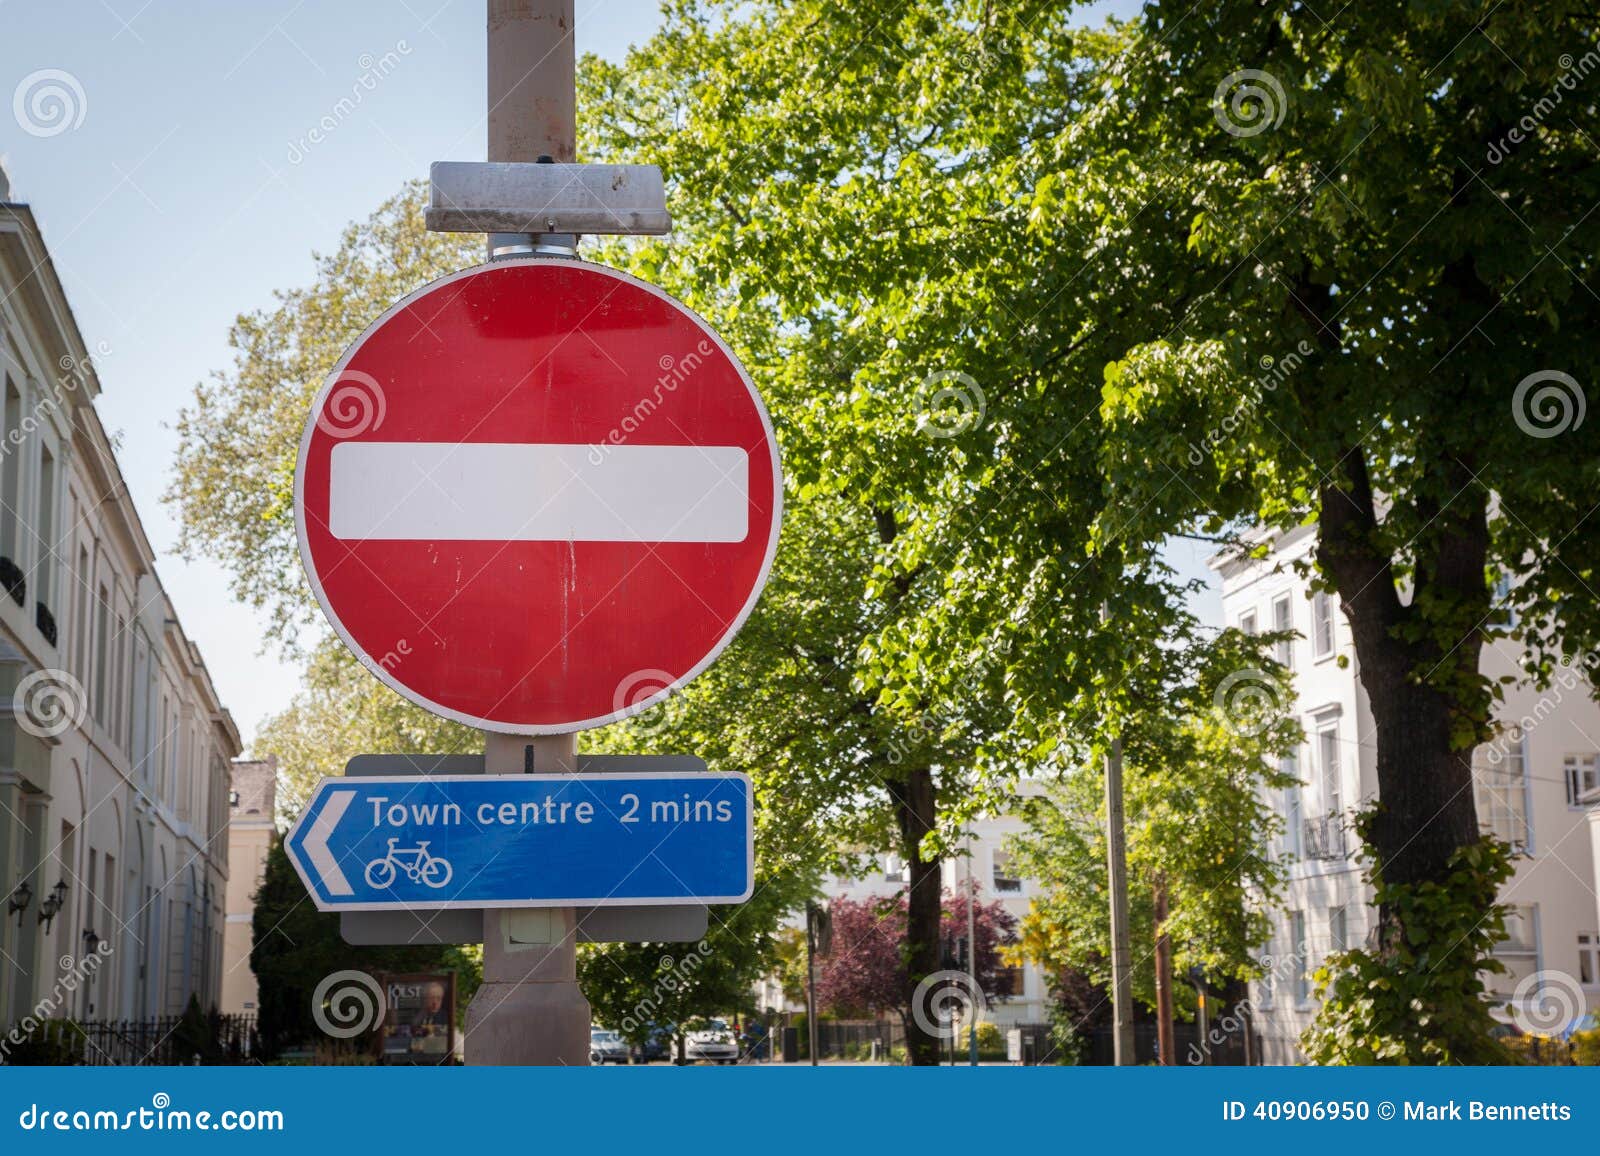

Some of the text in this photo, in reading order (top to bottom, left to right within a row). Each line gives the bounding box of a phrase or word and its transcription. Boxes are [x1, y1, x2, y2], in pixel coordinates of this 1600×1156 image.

[367, 793, 732, 827] Town centre 2 mins
